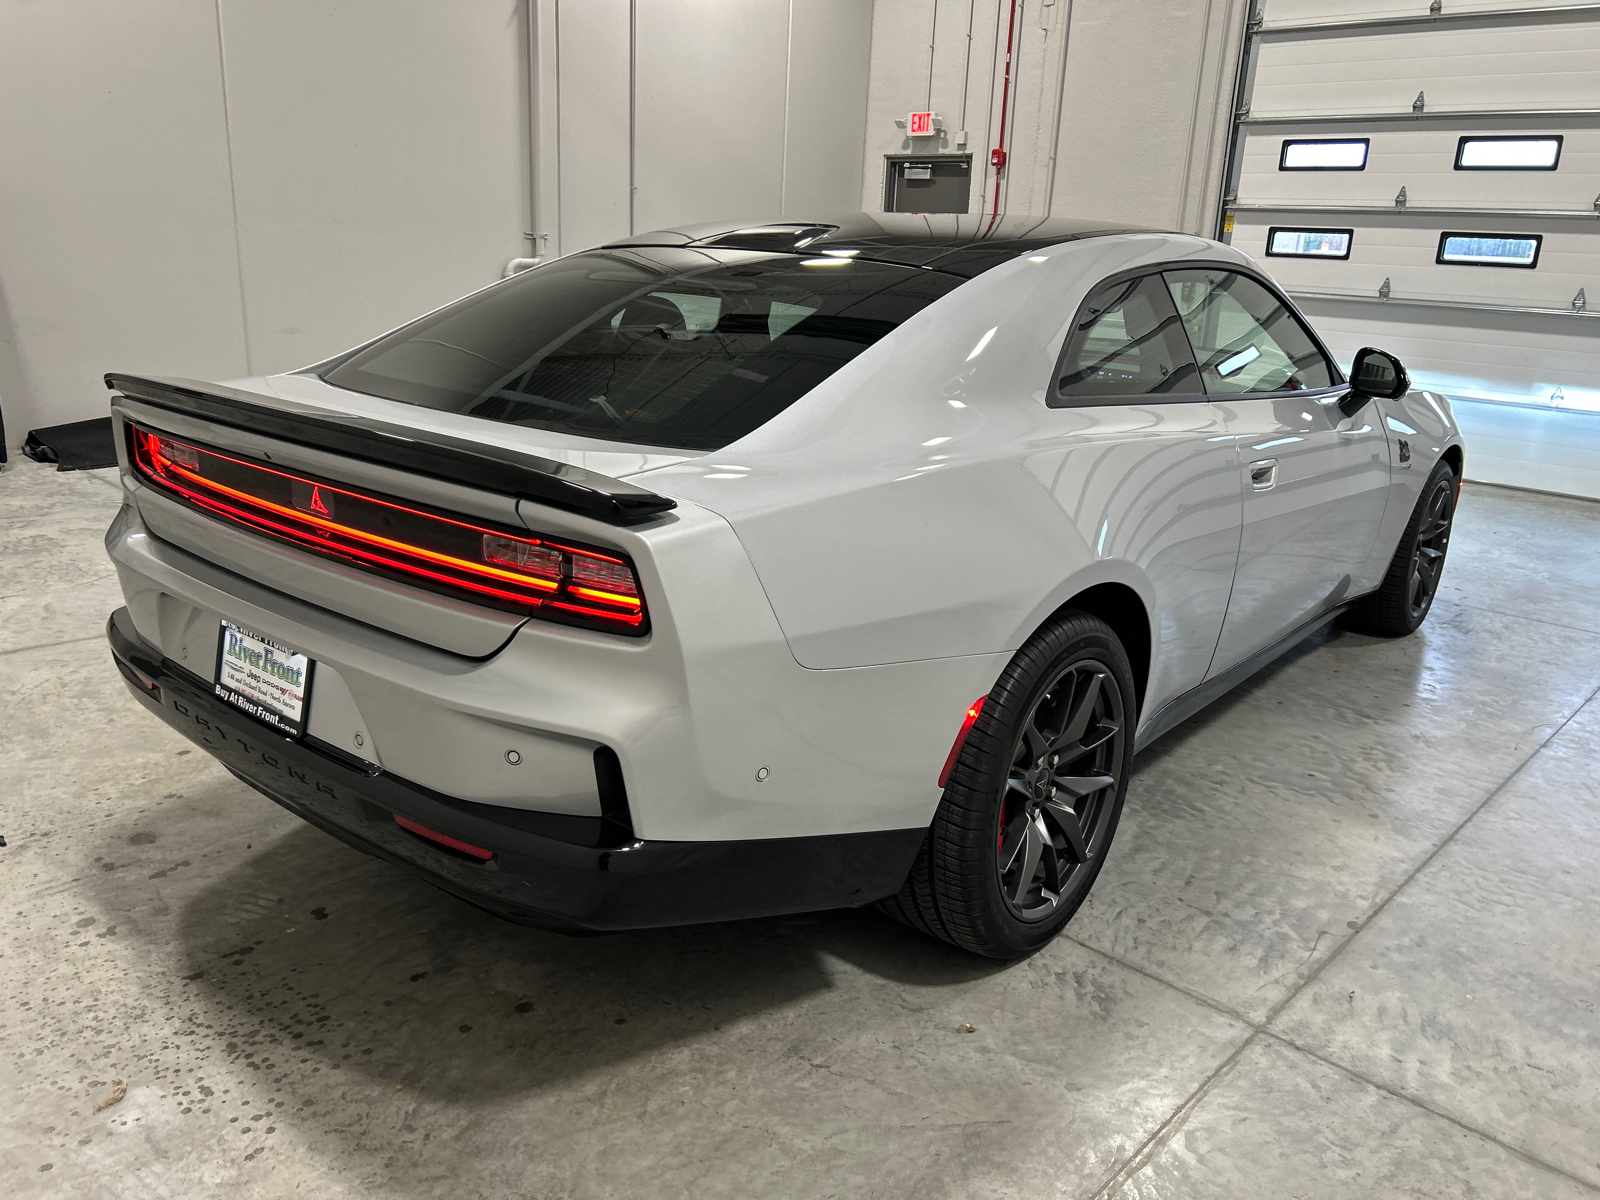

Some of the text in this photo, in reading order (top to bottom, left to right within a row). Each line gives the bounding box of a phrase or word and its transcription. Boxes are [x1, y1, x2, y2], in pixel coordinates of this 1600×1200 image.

[911, 113, 931, 132] EXIT
[247, 669, 261, 683] Jeep
[215, 684, 229, 700] Buy
[229, 691, 238, 703] At
[238, 696, 257, 714] River
